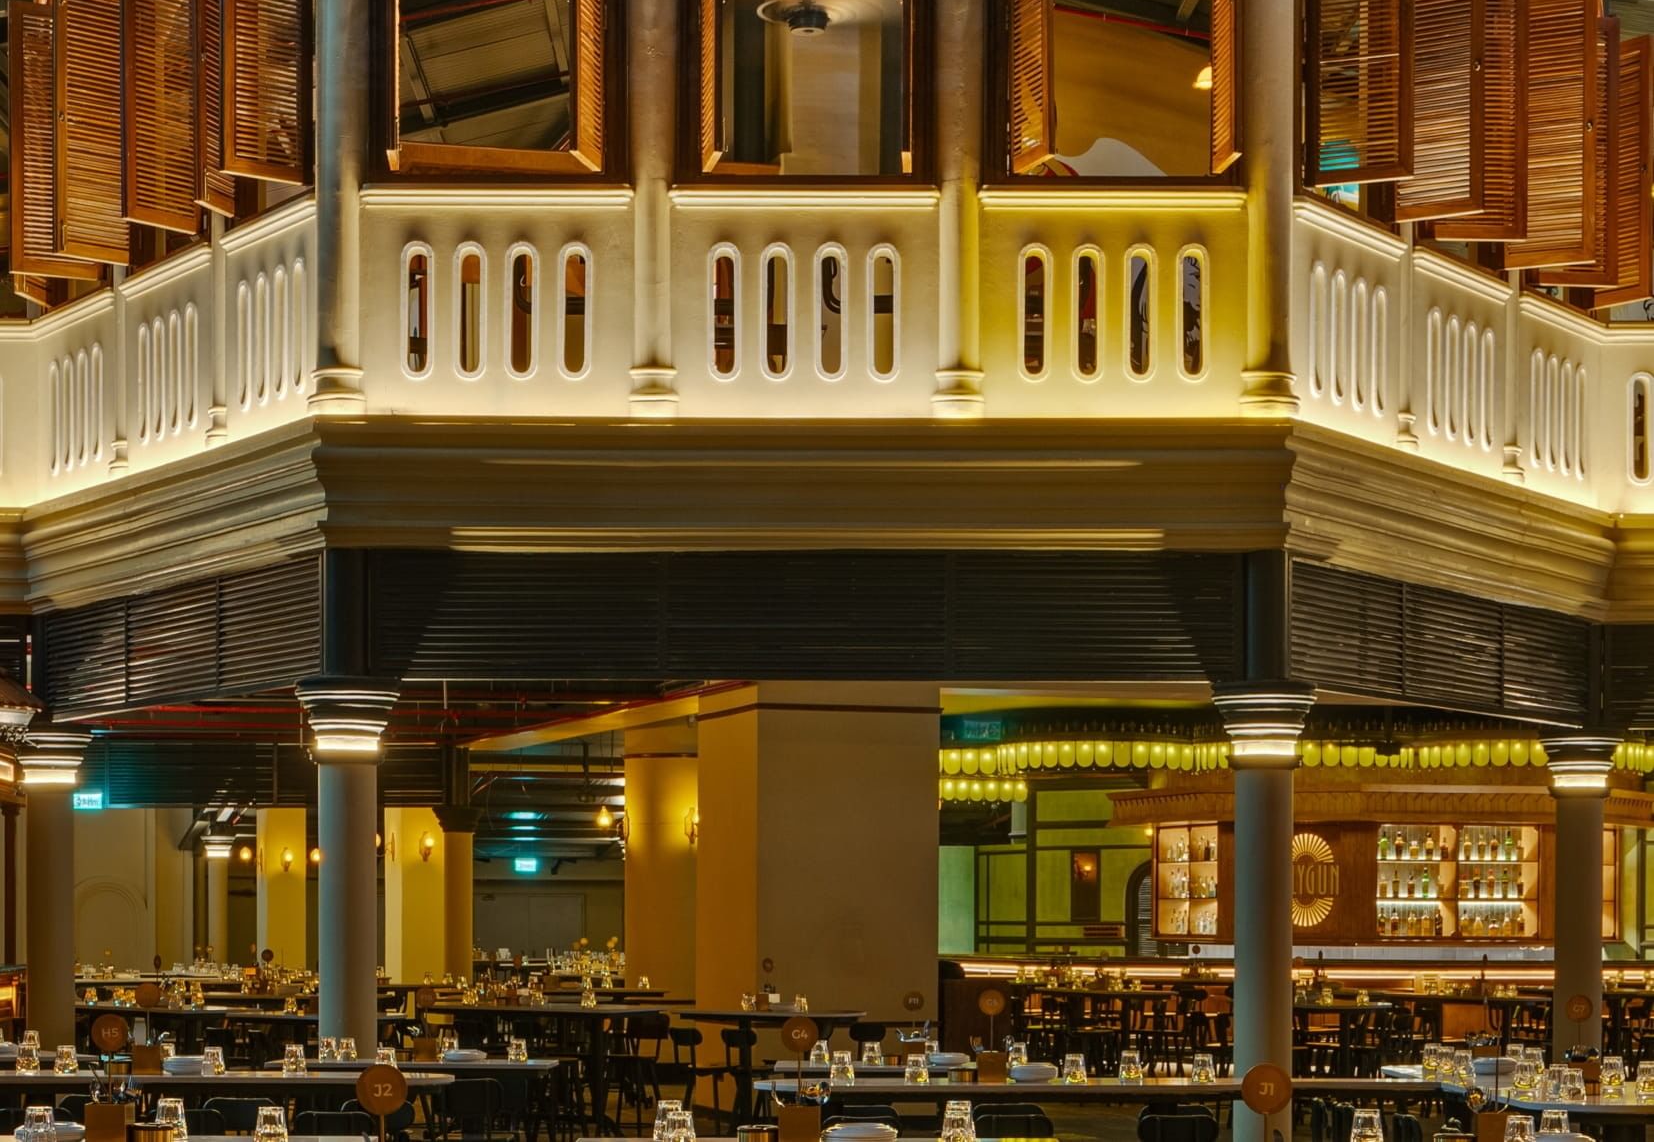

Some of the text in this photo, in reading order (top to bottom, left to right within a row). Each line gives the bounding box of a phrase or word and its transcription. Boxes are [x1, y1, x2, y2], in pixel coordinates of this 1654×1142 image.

[791, 1029, 808, 1040] G4
[373, 1083, 393, 1097] J2
[1258, 1081, 1274, 1096] J1
